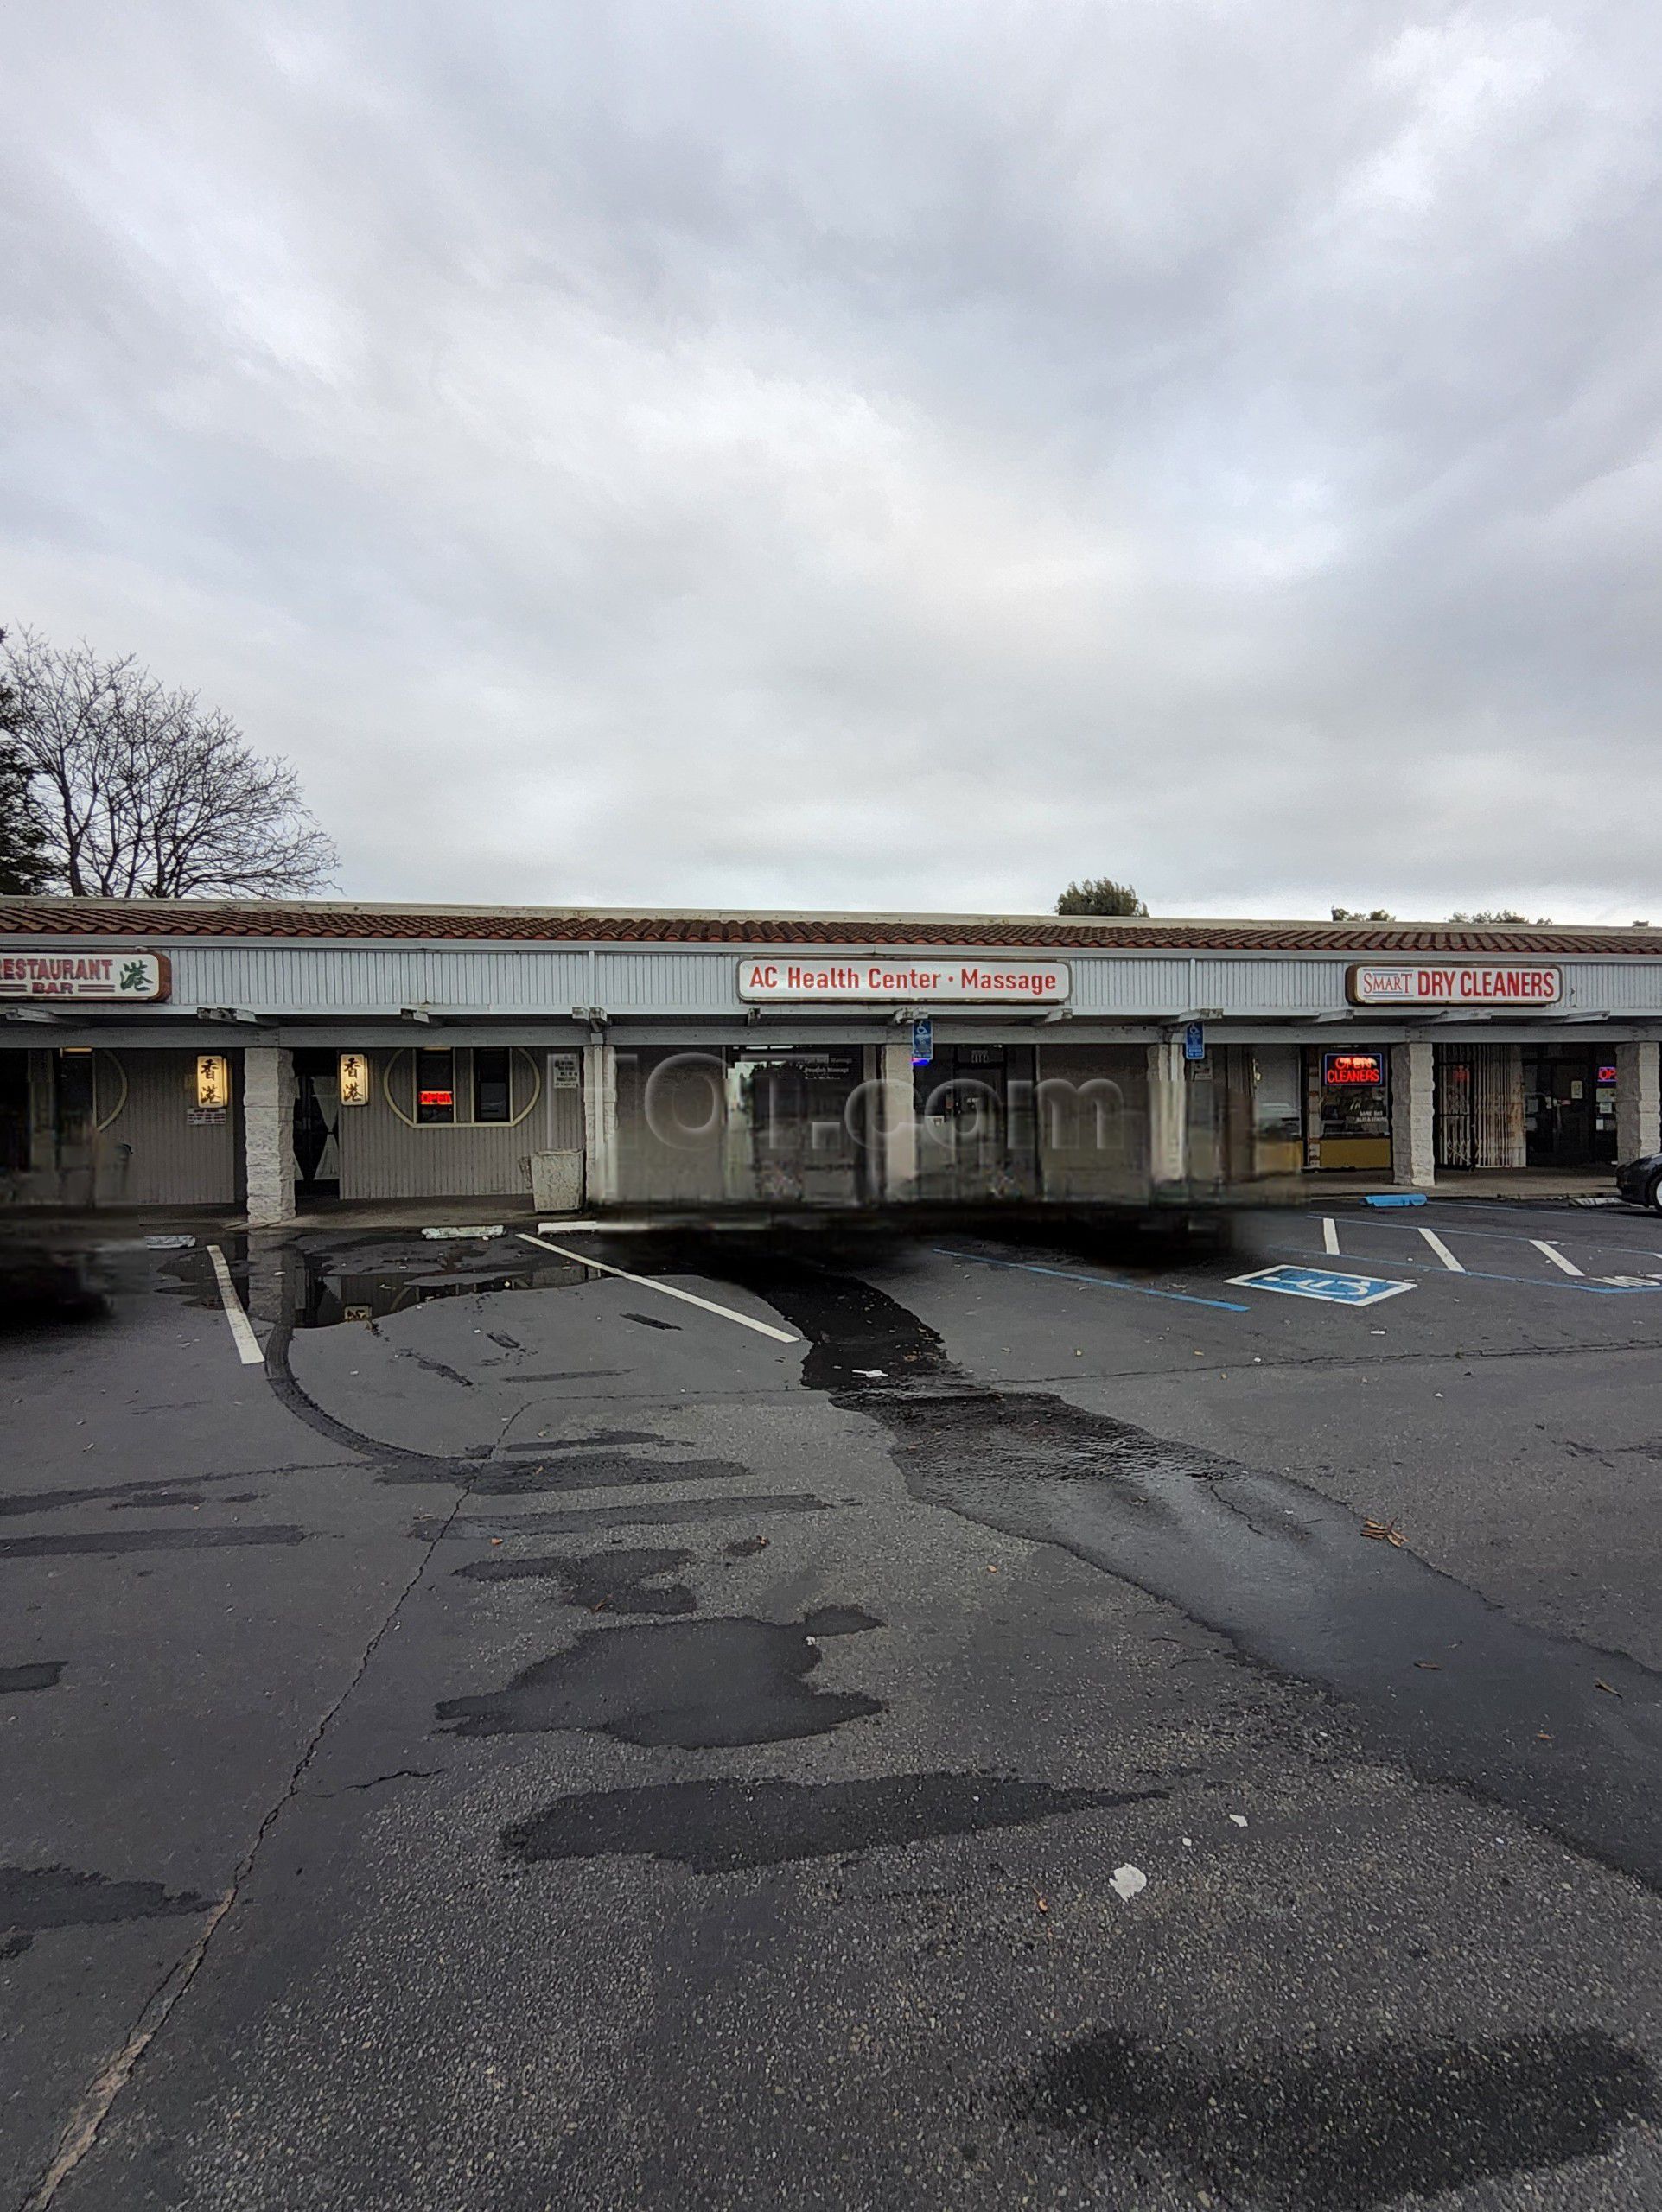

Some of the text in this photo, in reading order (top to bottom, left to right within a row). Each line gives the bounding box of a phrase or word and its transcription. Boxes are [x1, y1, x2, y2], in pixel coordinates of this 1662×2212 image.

[0, 958, 114, 981] ESTAURANT
[119, 959, 154, 992] 港
[749, 966, 1057, 995] AC Health Center Massage
[32, 982, 74, 995] BAR
[1363, 970, 1555, 998] SMART DRY CLEANERS
[200, 1058, 222, 1104] 香港
[343, 1057, 364, 1103] 香港
[1327, 1069, 1380, 1083] CLEANERS
[1598, 1068, 1616, 1080] OP
